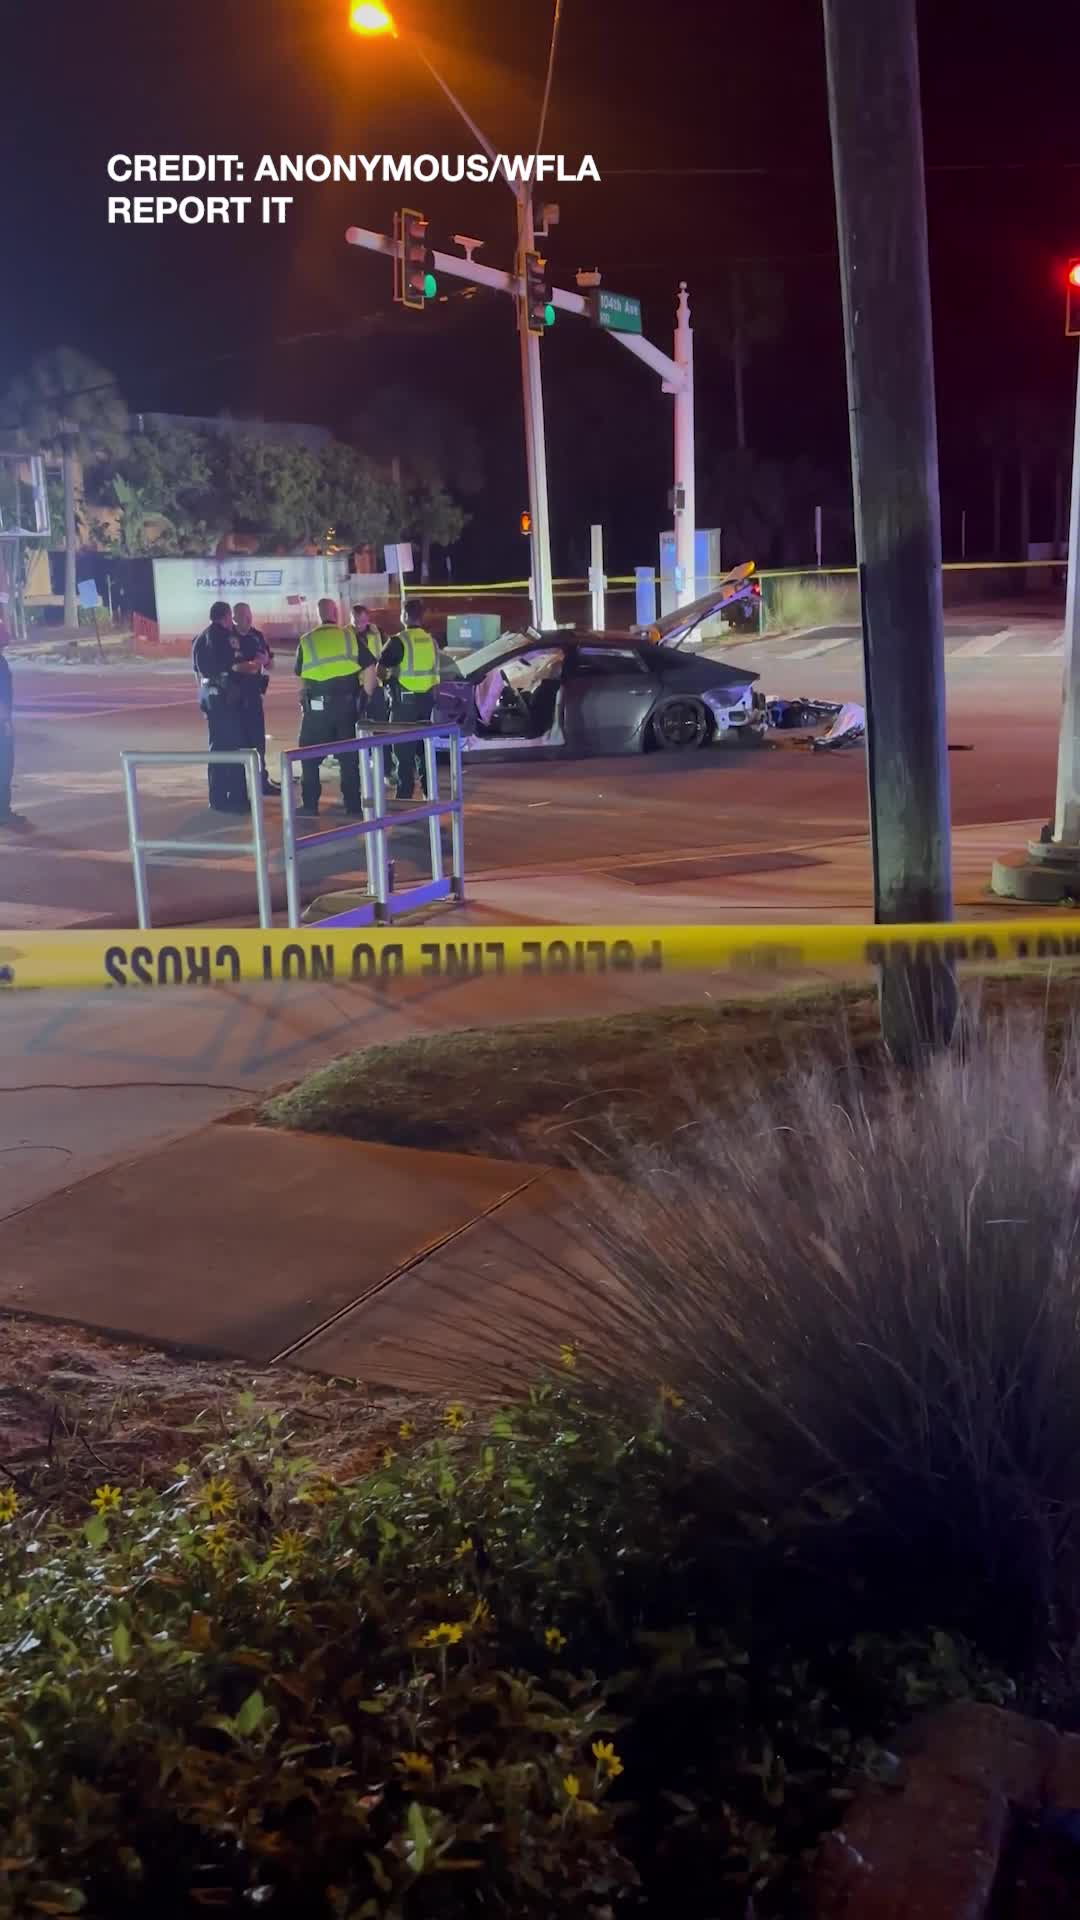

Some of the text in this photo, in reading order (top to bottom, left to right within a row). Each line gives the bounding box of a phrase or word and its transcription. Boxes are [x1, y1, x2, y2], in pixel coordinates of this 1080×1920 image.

[600, 295, 639, 316] 104th Ave
[196, 578, 252, 587] PACK-RAT
[104, 945, 241, 987] CROSS
